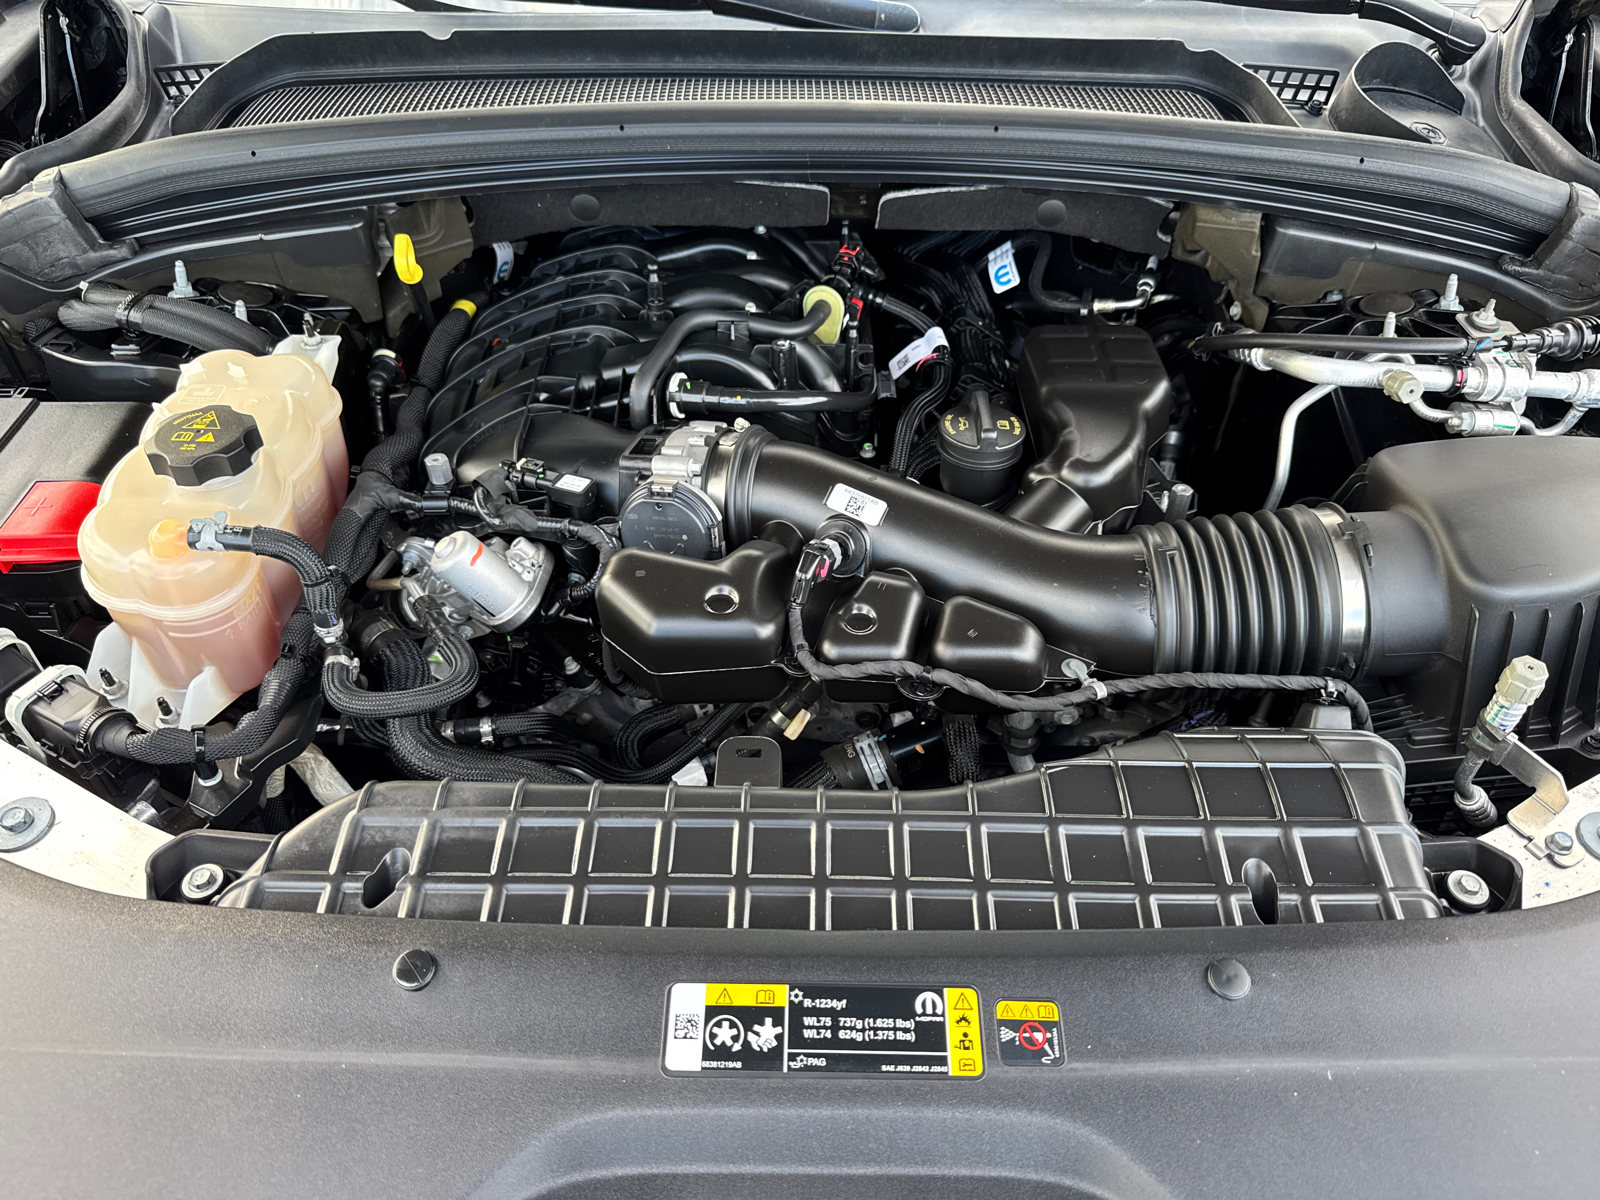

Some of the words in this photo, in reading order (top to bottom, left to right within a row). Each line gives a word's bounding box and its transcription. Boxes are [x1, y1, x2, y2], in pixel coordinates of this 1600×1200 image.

[844, 743, 856, 759] ENG
[803, 999, 847, 1010] R-1234yf
[802, 1016, 832, 1027] WL75
[838, 1017, 863, 1029] 737g
[864, 1018, 895, 1030] (1.625
[895, 1018, 915, 1030] lbs)
[802, 1028, 832, 1039] WL74
[838, 1029, 863, 1041] 624g
[864, 1030, 895, 1042] (1.375
[895, 1030, 916, 1043] lbs)
[807, 1058, 827, 1067] PAG
